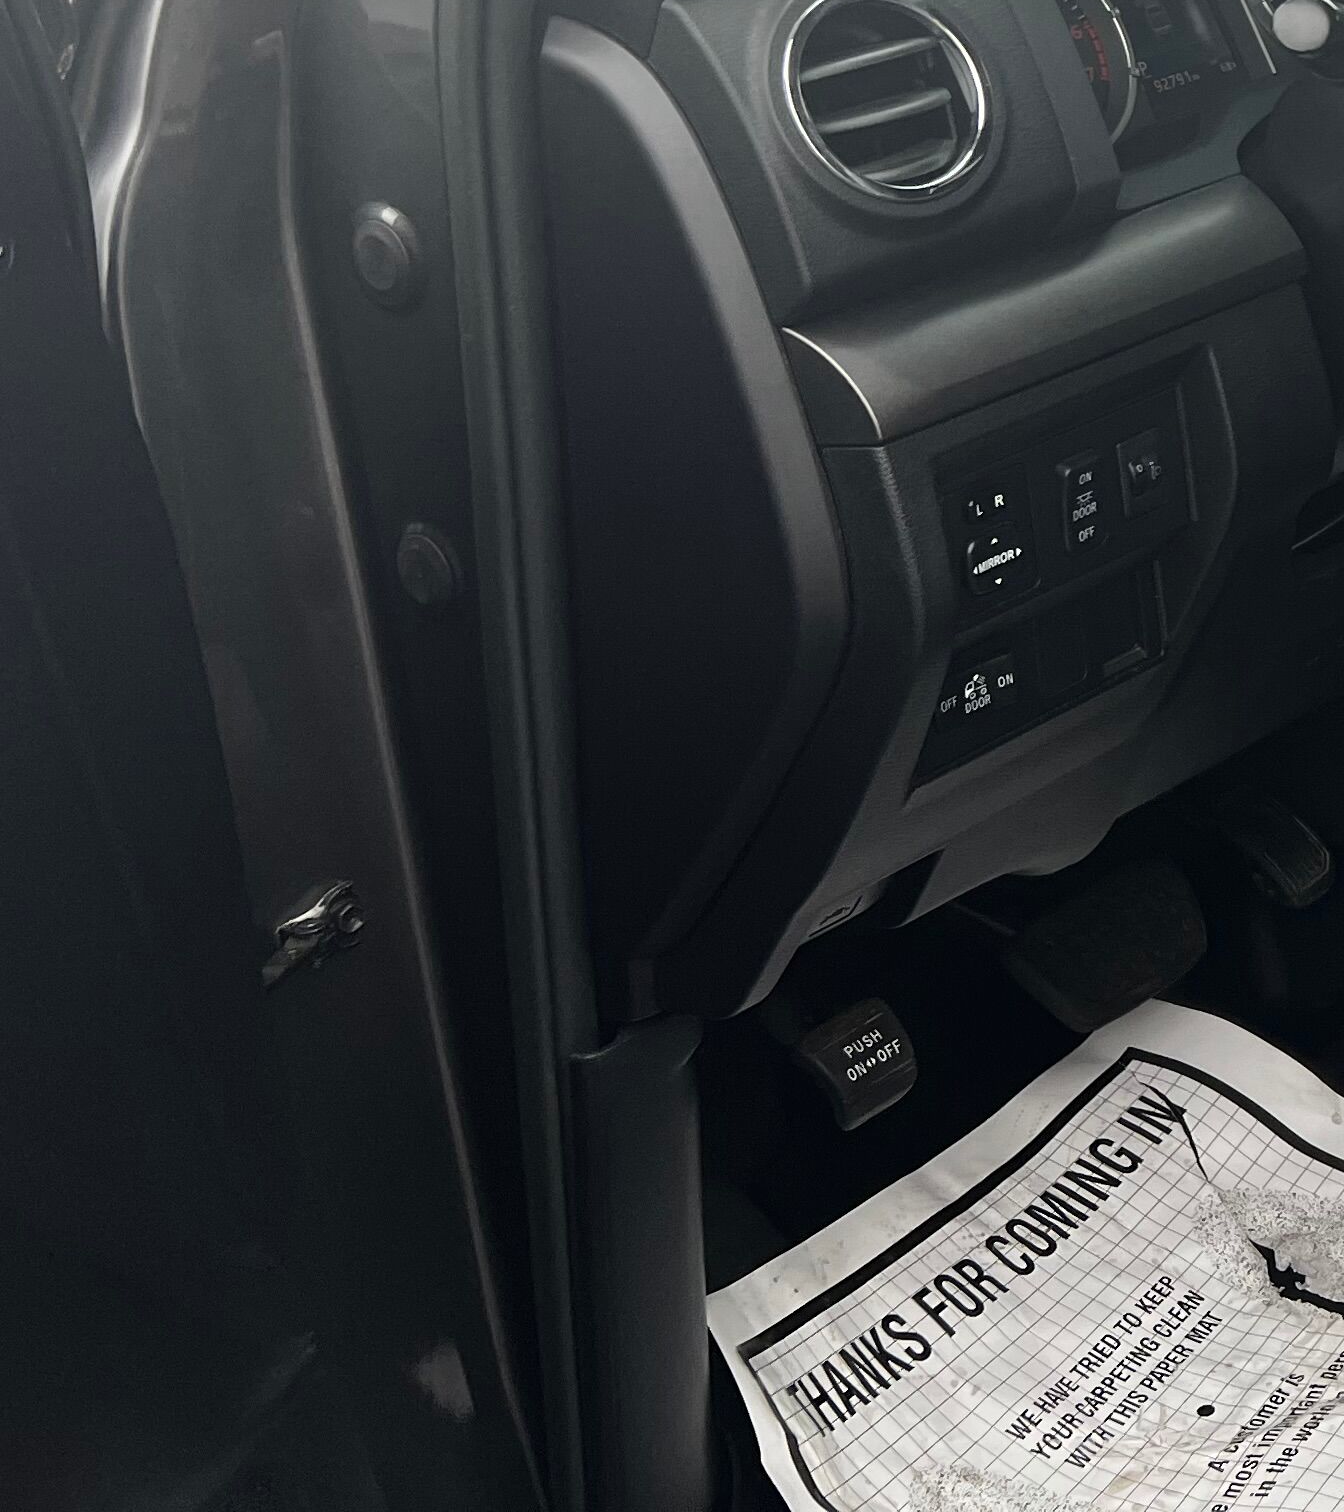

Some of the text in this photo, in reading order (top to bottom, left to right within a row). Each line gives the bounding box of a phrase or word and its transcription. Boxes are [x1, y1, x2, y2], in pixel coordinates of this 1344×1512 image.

[1071, 24, 1082, 40] 6
[1153, 70, 1192, 93] 92791
[1079, 471, 1092, 485] ON
[976, 504, 983, 518] L
[994, 494, 1004, 508] R
[1072, 501, 1097, 522] DOOR
[1078, 526, 1095, 542] OFF
[978, 548, 1015, 574] MIRROR
[997, 673, 1014, 688] ON
[940, 695, 958, 713] OFF
[964, 694, 991, 714] DOOR
[843, 1029, 883, 1058] PUSH
[846, 1038, 901, 1081] ON OFF
[786, 1095, 1187, 1437] THANKS FOR COMING IN
[1005, 1275, 1176, 1440] WE HAVE TRIED TO KEEP
[1030, 1289, 1206, 1460] YOUR CARPETING CLEAN
[1064, 1310, 1223, 1469] WITH THIS PAPER MAT
[1207, 1459, 1229, 1473] A
[1280, 1373, 1305, 1388] is
[1223, 1452, 1265, 1499] most
[1249, 1479, 1277, 1497] in
[1265, 1447, 1299, 1473] the
